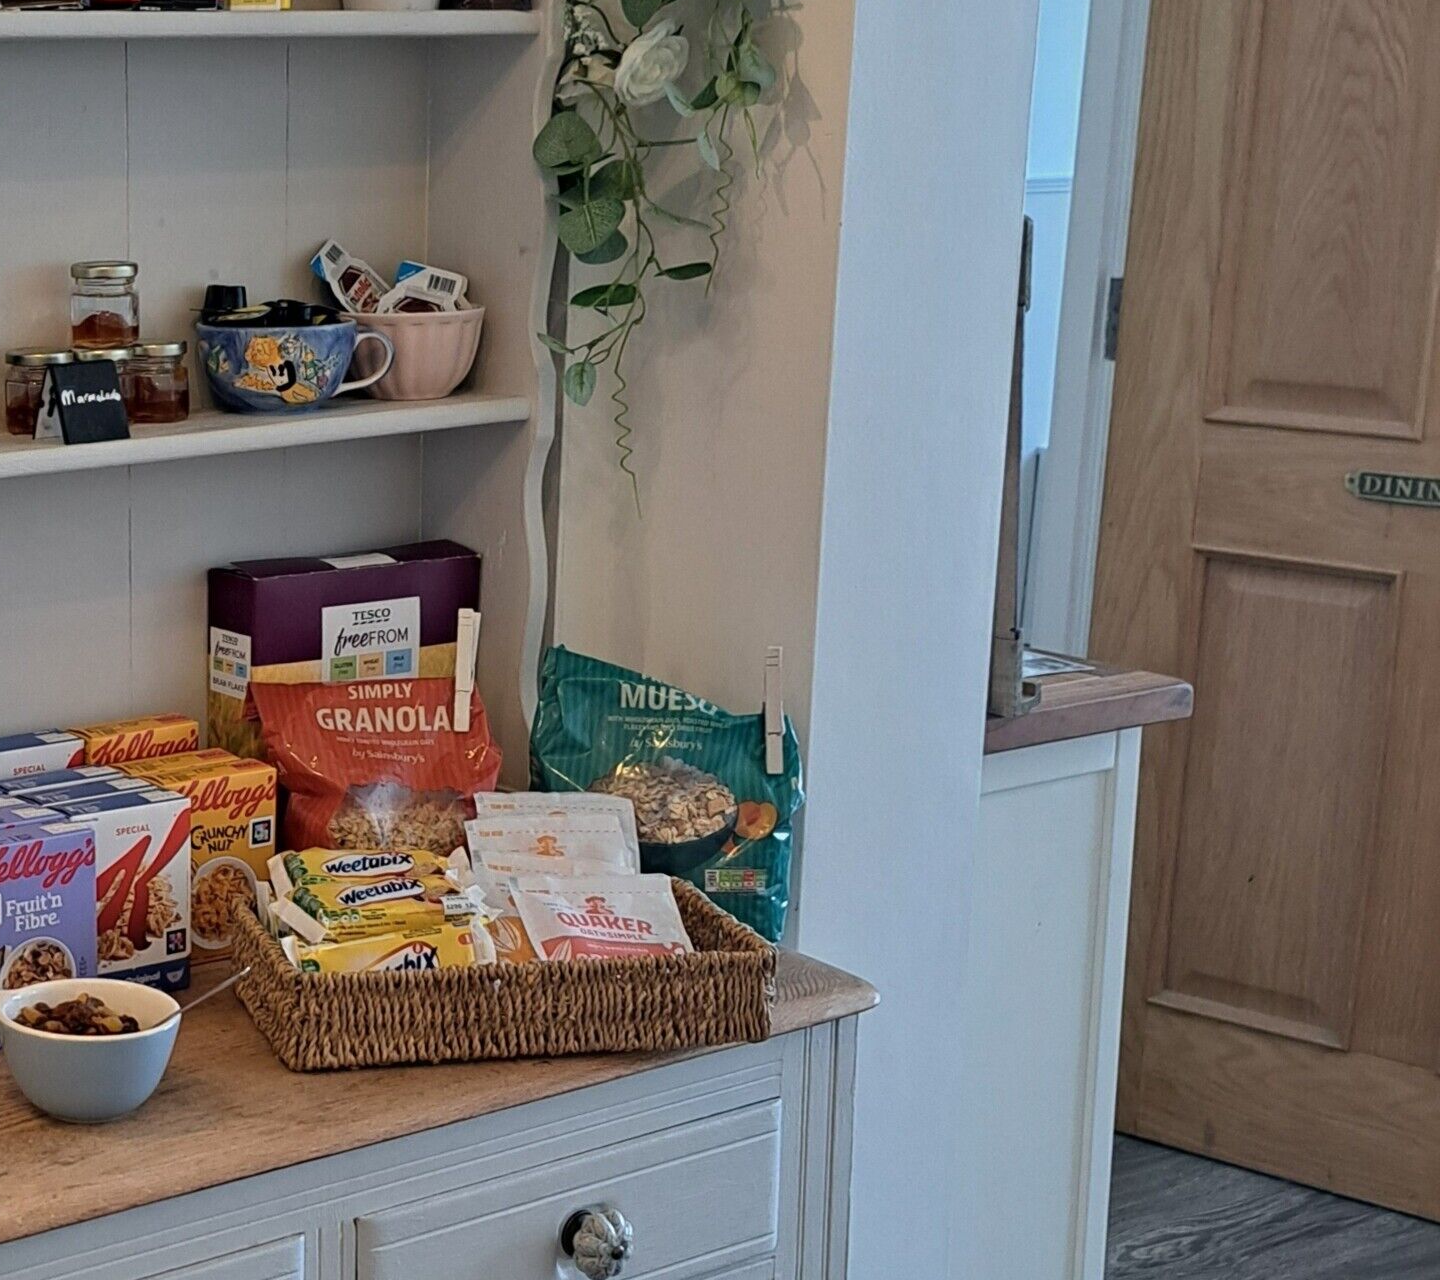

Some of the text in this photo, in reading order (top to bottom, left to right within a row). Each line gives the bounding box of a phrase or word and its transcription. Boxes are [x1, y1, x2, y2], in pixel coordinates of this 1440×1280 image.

[352, 607, 392, 621] TESCO
[334, 626, 409, 657] freeFROM
[347, 681, 414, 700] SIMPLY
[315, 704, 452, 733] GRANOLA
[13, 763, 46, 776] SPECIAL
[115, 823, 151, 837] SPECIAL
[190, 822, 249, 851] CRUNCHY
[207, 838, 235, 855] NUT
[324, 851, 413, 875] Weetabix
[339, 877, 424, 906] Weetabix
[14, 910, 61, 933] Fibre
[556, 911, 655, 936] QUAKER
